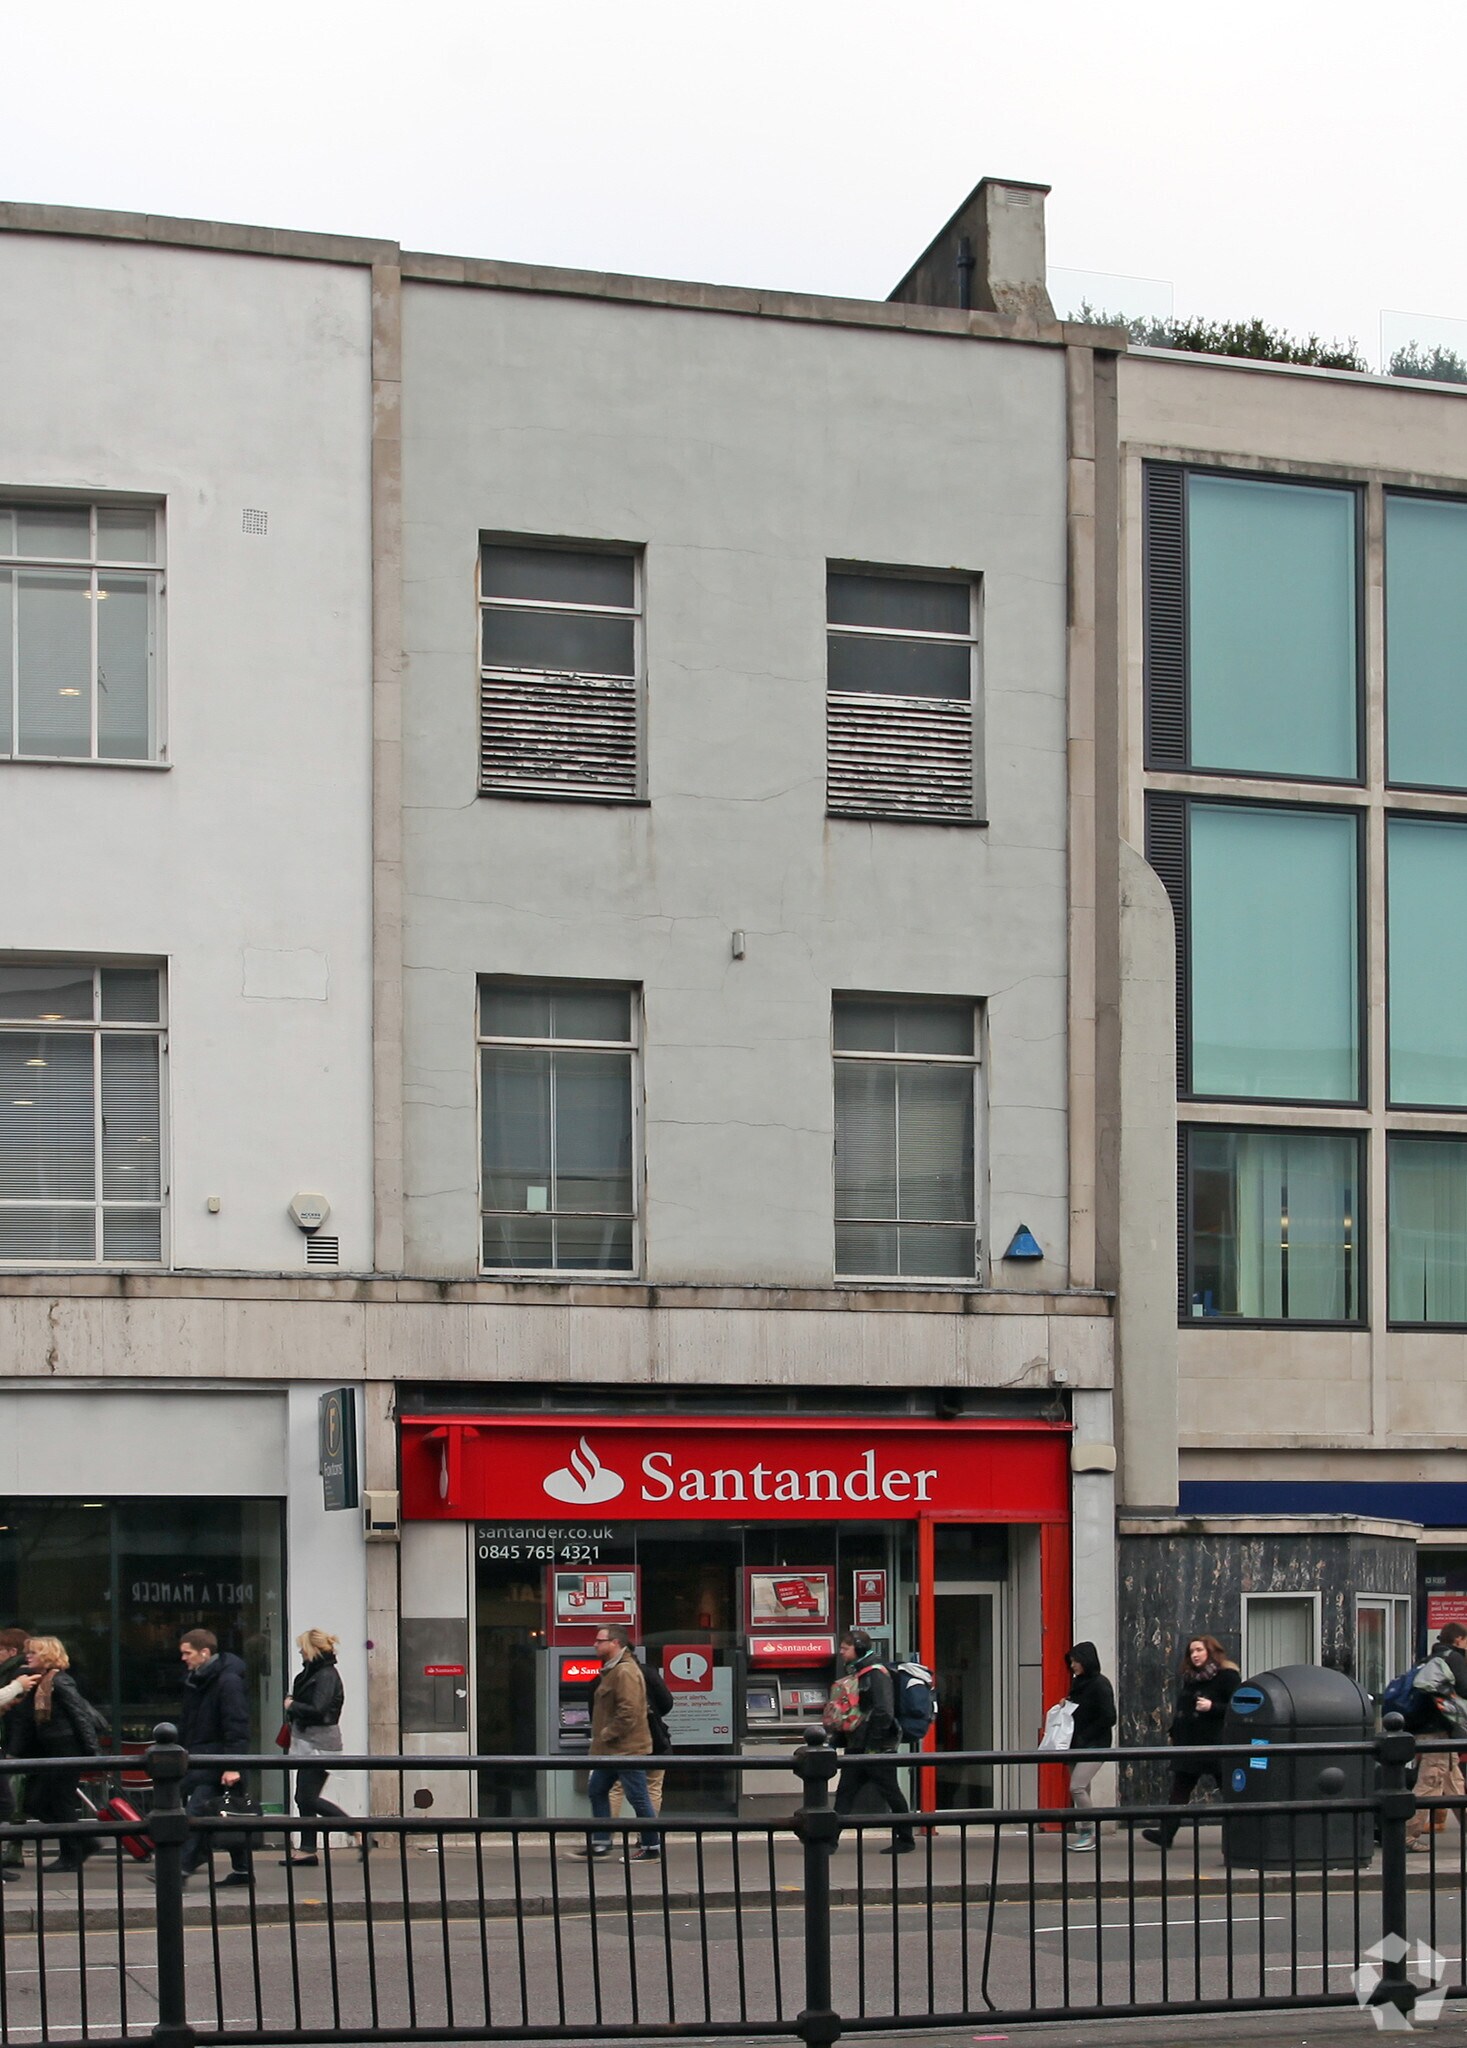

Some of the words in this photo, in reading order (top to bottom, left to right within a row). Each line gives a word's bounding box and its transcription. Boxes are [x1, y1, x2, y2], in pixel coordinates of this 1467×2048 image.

[641, 1449, 938, 1501] Santander
[479, 1525, 613, 1539] santander.co.uk
[479, 1545, 520, 1559] 0845
[525, 1545, 555, 1559] 765
[560, 1545, 599, 1559] 4321
[777, 1643, 822, 1652] Santander
